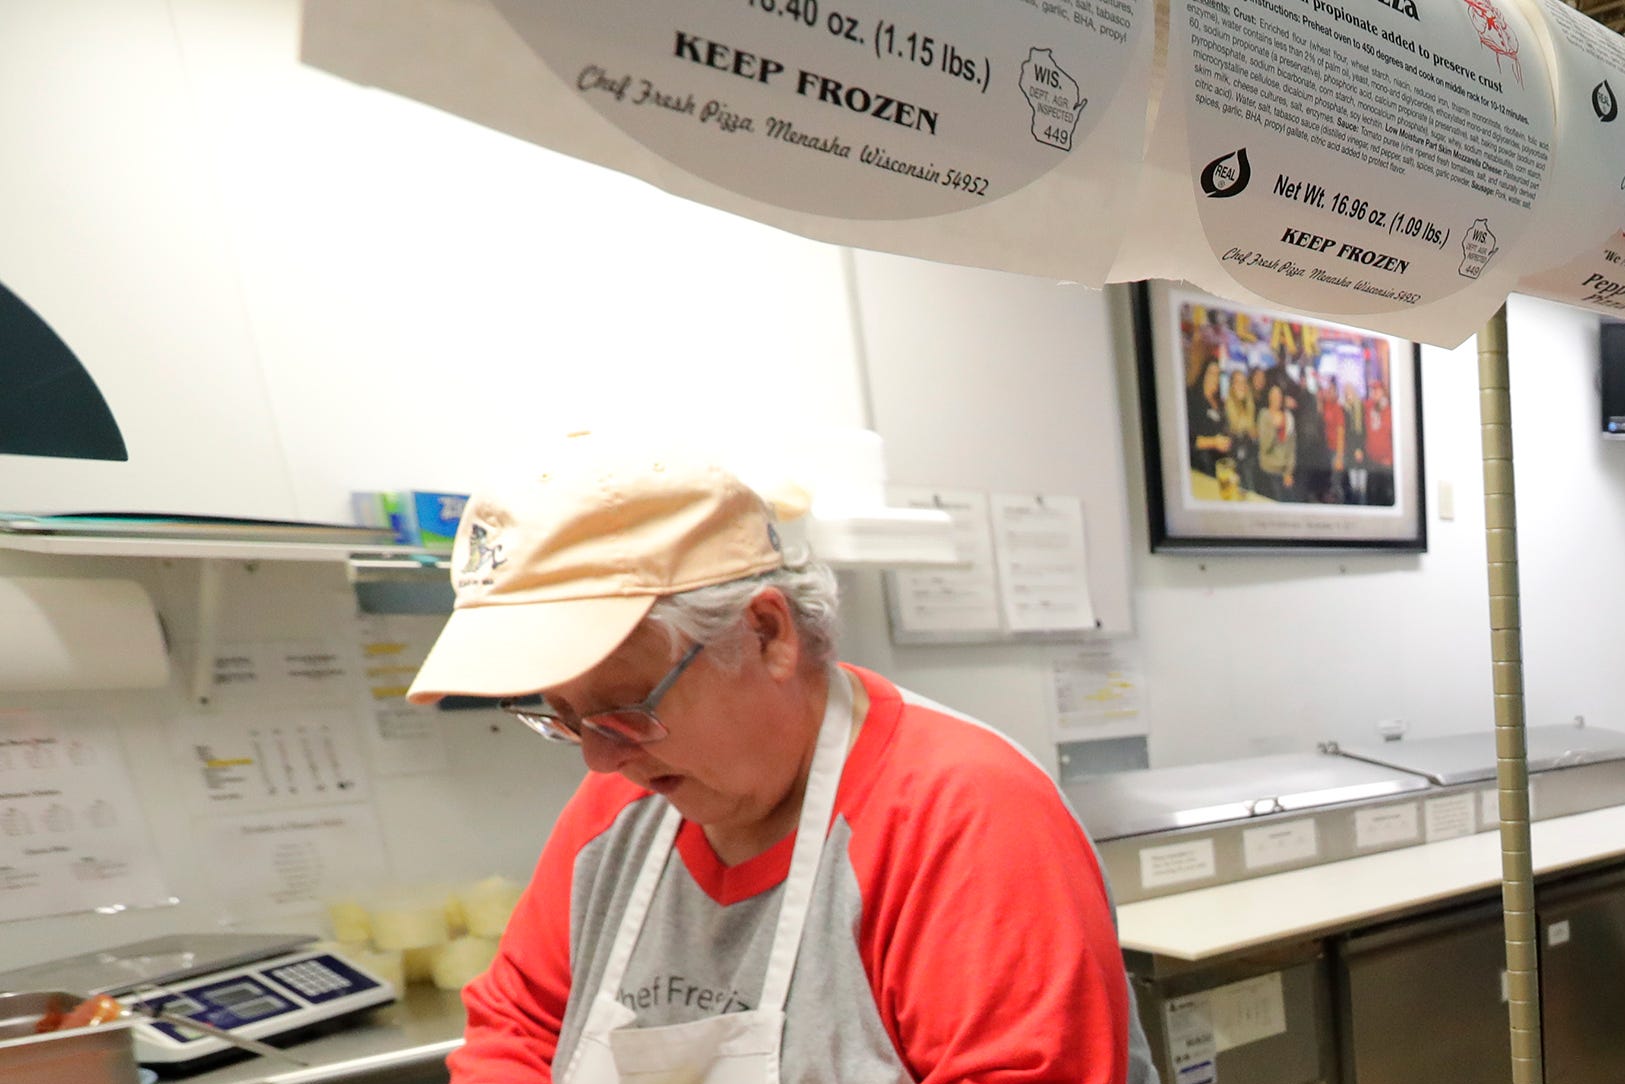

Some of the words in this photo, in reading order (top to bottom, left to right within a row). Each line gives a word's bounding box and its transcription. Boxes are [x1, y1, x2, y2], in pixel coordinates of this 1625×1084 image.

[1042, 1, 1070, 21] garlic,
[1074, 11, 1096, 31] BHA,
[1100, 25, 1126, 44] propyl
[1096, 6, 1131, 29] tabasco
[1233, 7, 1256, 25] Crust:
[1260, 18, 1289, 39] Enriched
[1292, 32, 1306, 46] flour
[827, 12, 864, 44] oz.
[875, 20, 934, 67] (1.15
[942, 44, 990, 93] lbs.)
[1191, 34, 1247, 64] pyrophosphate,
[1250, 58, 1275, 74] sodium
[1277, 67, 1317, 92] bicarbonate,
[1203, 24, 1230, 42] sodium
[1232, 36, 1269, 58] propionate
[1323, 74, 1357, 94] phosphoric
[1221, 18, 1242, 32] water
[1243, 26, 1272, 46] contains
[1274, 38, 1288, 52] less
[1288, 44, 1303, 58] than
[1304, 50, 1316, 64] 2%
[1325, 61, 1340, 74] palm
[1302, 15, 1332, 37] Preheat
[1333, 31, 1352, 46] oven
[1352, 38, 1361, 50] to
[1362, 42, 1375, 56] 450
[1376, 50, 1404, 69] degrees
[1404, 63, 1417, 75] and
[1418, 70, 1434, 82] cook
[1435, 77, 1444, 86] on
[1445, 81, 1466, 96] middle
[1466, 91, 1480, 103] rack
[1480, 96, 1489, 107] for
[1490, 100, 1505, 115] 10-12
[1506, 108, 1529, 125] minutes.
[1313, 0, 1378, 36] propionate
[1381, 30, 1415, 53] added
[1418, 44, 1430, 59] to
[1433, 54, 1476, 81] preserve
[1478, 75, 1503, 94] crust
[674, 32, 784, 84] KEEP
[797, 70, 938, 135] FROZEN
[1034, 64, 1062, 90] WIS.
[1194, 64, 1212, 77] skim
[1233, 79, 1258, 95] cheese
[1260, 89, 1288, 108] cultures,
[1336, 117, 1359, 133] Sauce:
[1194, 79, 1213, 92] citric
[1274, 107, 1300, 124] tabasco
[577, 64, 632, 101] Chef
[632, 80, 695, 115] Fresh
[700, 100, 753, 133] Pizza
[766, 116, 851, 158] Menasha
[860, 144, 940, 183] Wisconsin
[941, 169, 989, 196] 54952
[1037, 102, 1074, 124] INSPECTED
[1044, 125, 1068, 144] 449
[1193, 49, 1248, 78] microcrystalline
[1250, 71, 1280, 91] cellulose,
[1314, 96, 1348, 118] phosphate,
[1385, 122, 1398, 135] Low
[1398, 128, 1424, 145] Moisture
[1425, 138, 1437, 150] Part
[1438, 144, 1452, 156] Skim
[1453, 149, 1480, 168] Mozzarella
[1195, 94, 1220, 110] spices,
[1222, 103, 1243, 118] garlic,
[1264, 118, 1285, 133] propyl
[1310, 135, 1326, 147] citric
[1326, 141, 1340, 152] acid
[1214, 163, 1237, 182] REAL
[1273, 174, 1302, 200] Net
[1303, 183, 1325, 208] Wt.
[1331, 192, 1368, 220] 16.96
[1368, 210, 1386, 228] oz.
[1388, 212, 1422, 237] (1.09
[1420, 220, 1450, 250] lbs.)
[1471, 227, 1487, 244] WIS.
[1222, 248, 1253, 266] Chef
[1246, 251, 1280, 273] Fresh
[1276, 259, 1306, 277] Pizza
[1309, 268, 1352, 288] Menasha
[1353, 279, 1394, 299] Wisconsin
[1394, 290, 1421, 305] 54952
[1280, 228, 1336, 253] KEEP
[1336, 244, 1410, 274] FROZEN
[1465, 265, 1480, 278] 449
[619, 976, 661, 1011] hef
